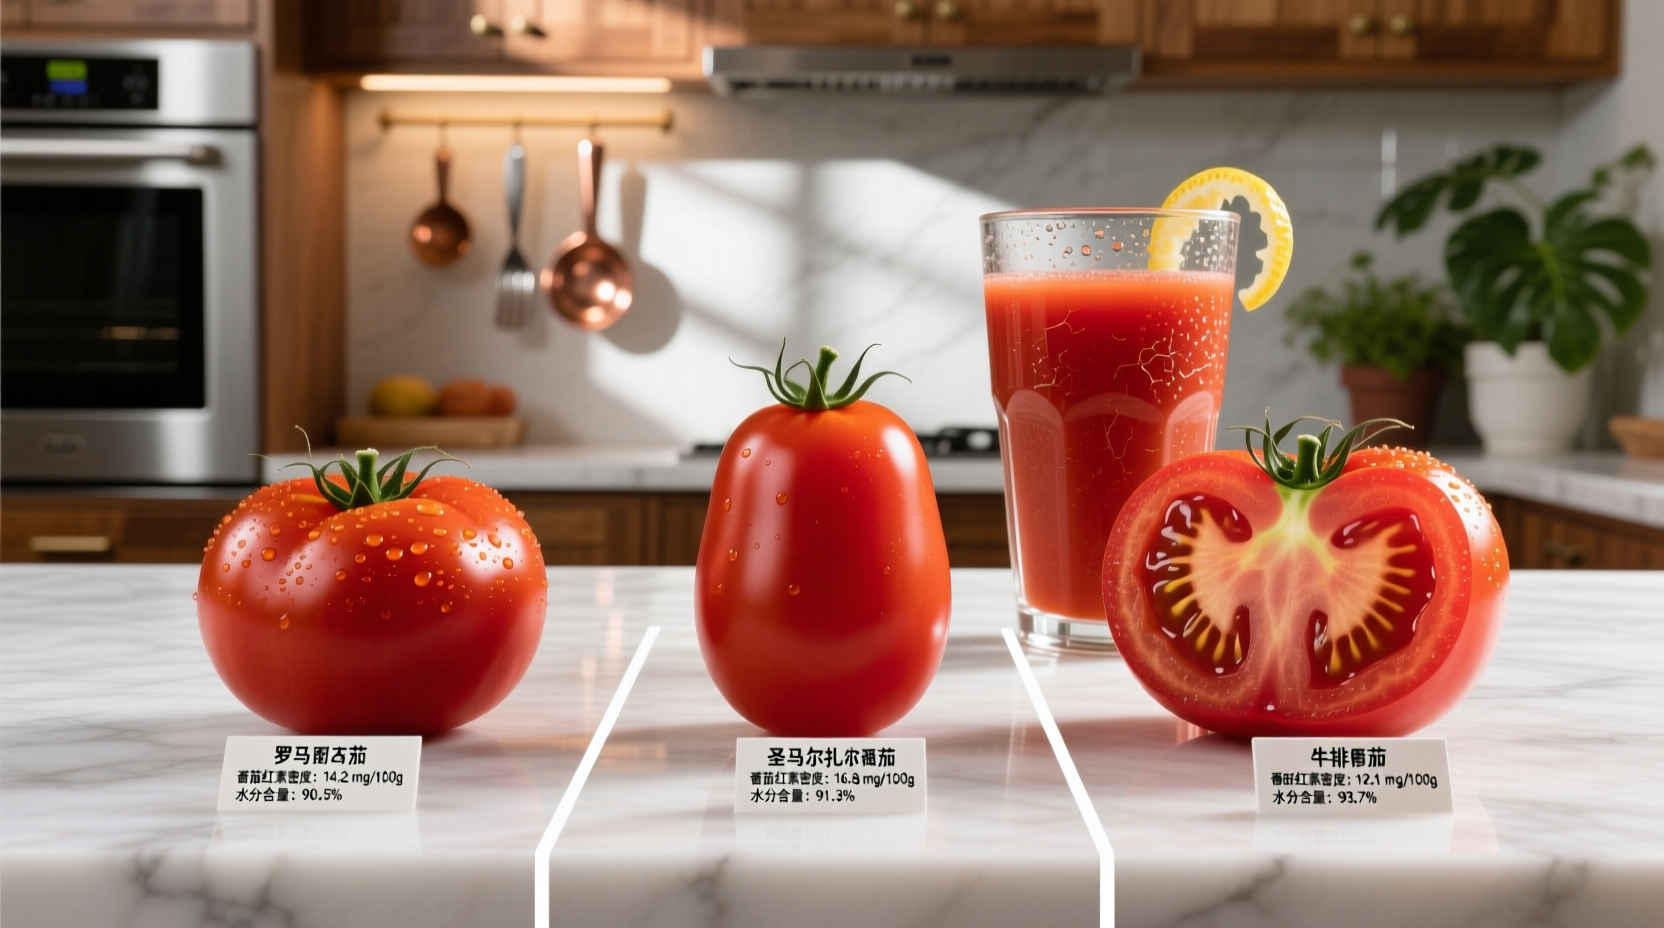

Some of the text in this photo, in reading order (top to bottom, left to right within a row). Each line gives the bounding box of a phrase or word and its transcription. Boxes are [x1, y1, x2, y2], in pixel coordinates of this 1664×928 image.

[862, 771, 915, 788] mg/100g
[1384, 772, 1438, 790] mg/100g
[301, 787, 343, 802] 90.5%
[815, 789, 856, 803] 91.3%
[1337, 790, 1378, 805] 93.7%
